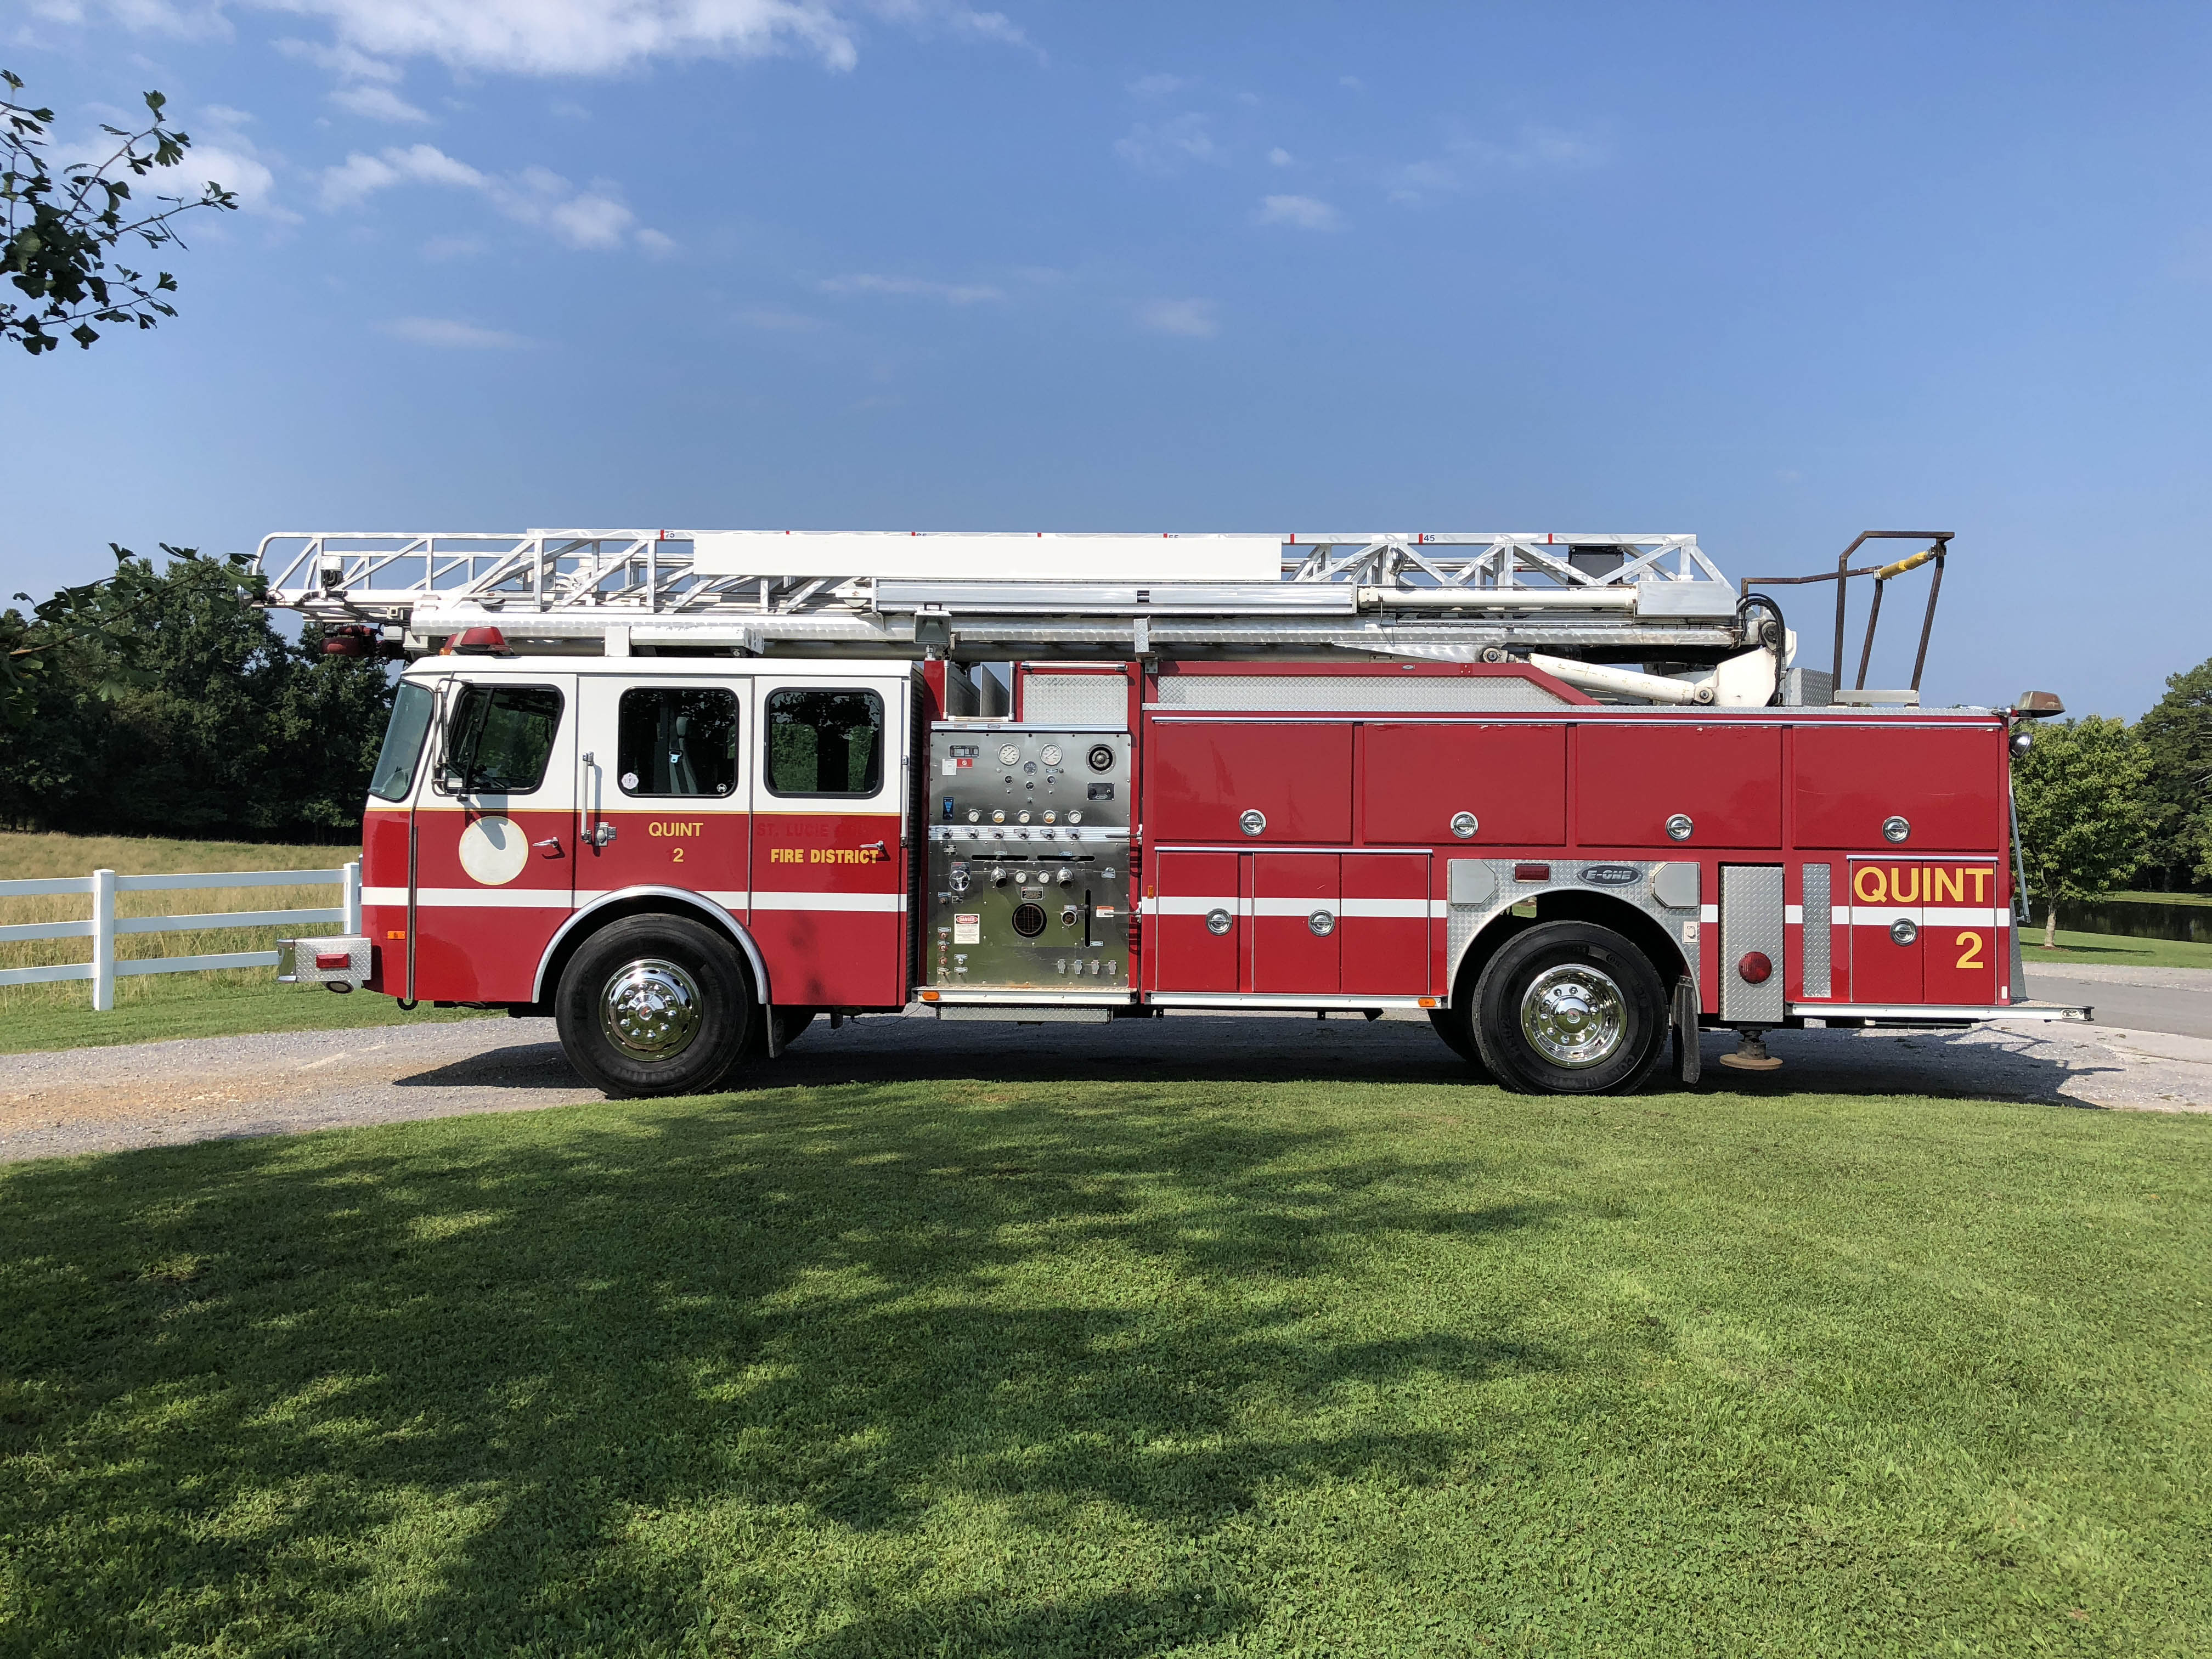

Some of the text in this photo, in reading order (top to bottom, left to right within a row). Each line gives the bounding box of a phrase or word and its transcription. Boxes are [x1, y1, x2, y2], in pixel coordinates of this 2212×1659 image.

[648, 822, 704, 837] QUINT
[673, 848, 684, 862] 2
[771, 849, 879, 864] FIRE DISTRICT
[1586, 870, 1633, 880] E-ONE
[1854, 866, 1994, 902] QUINT
[1956, 931, 1984, 968] 2
